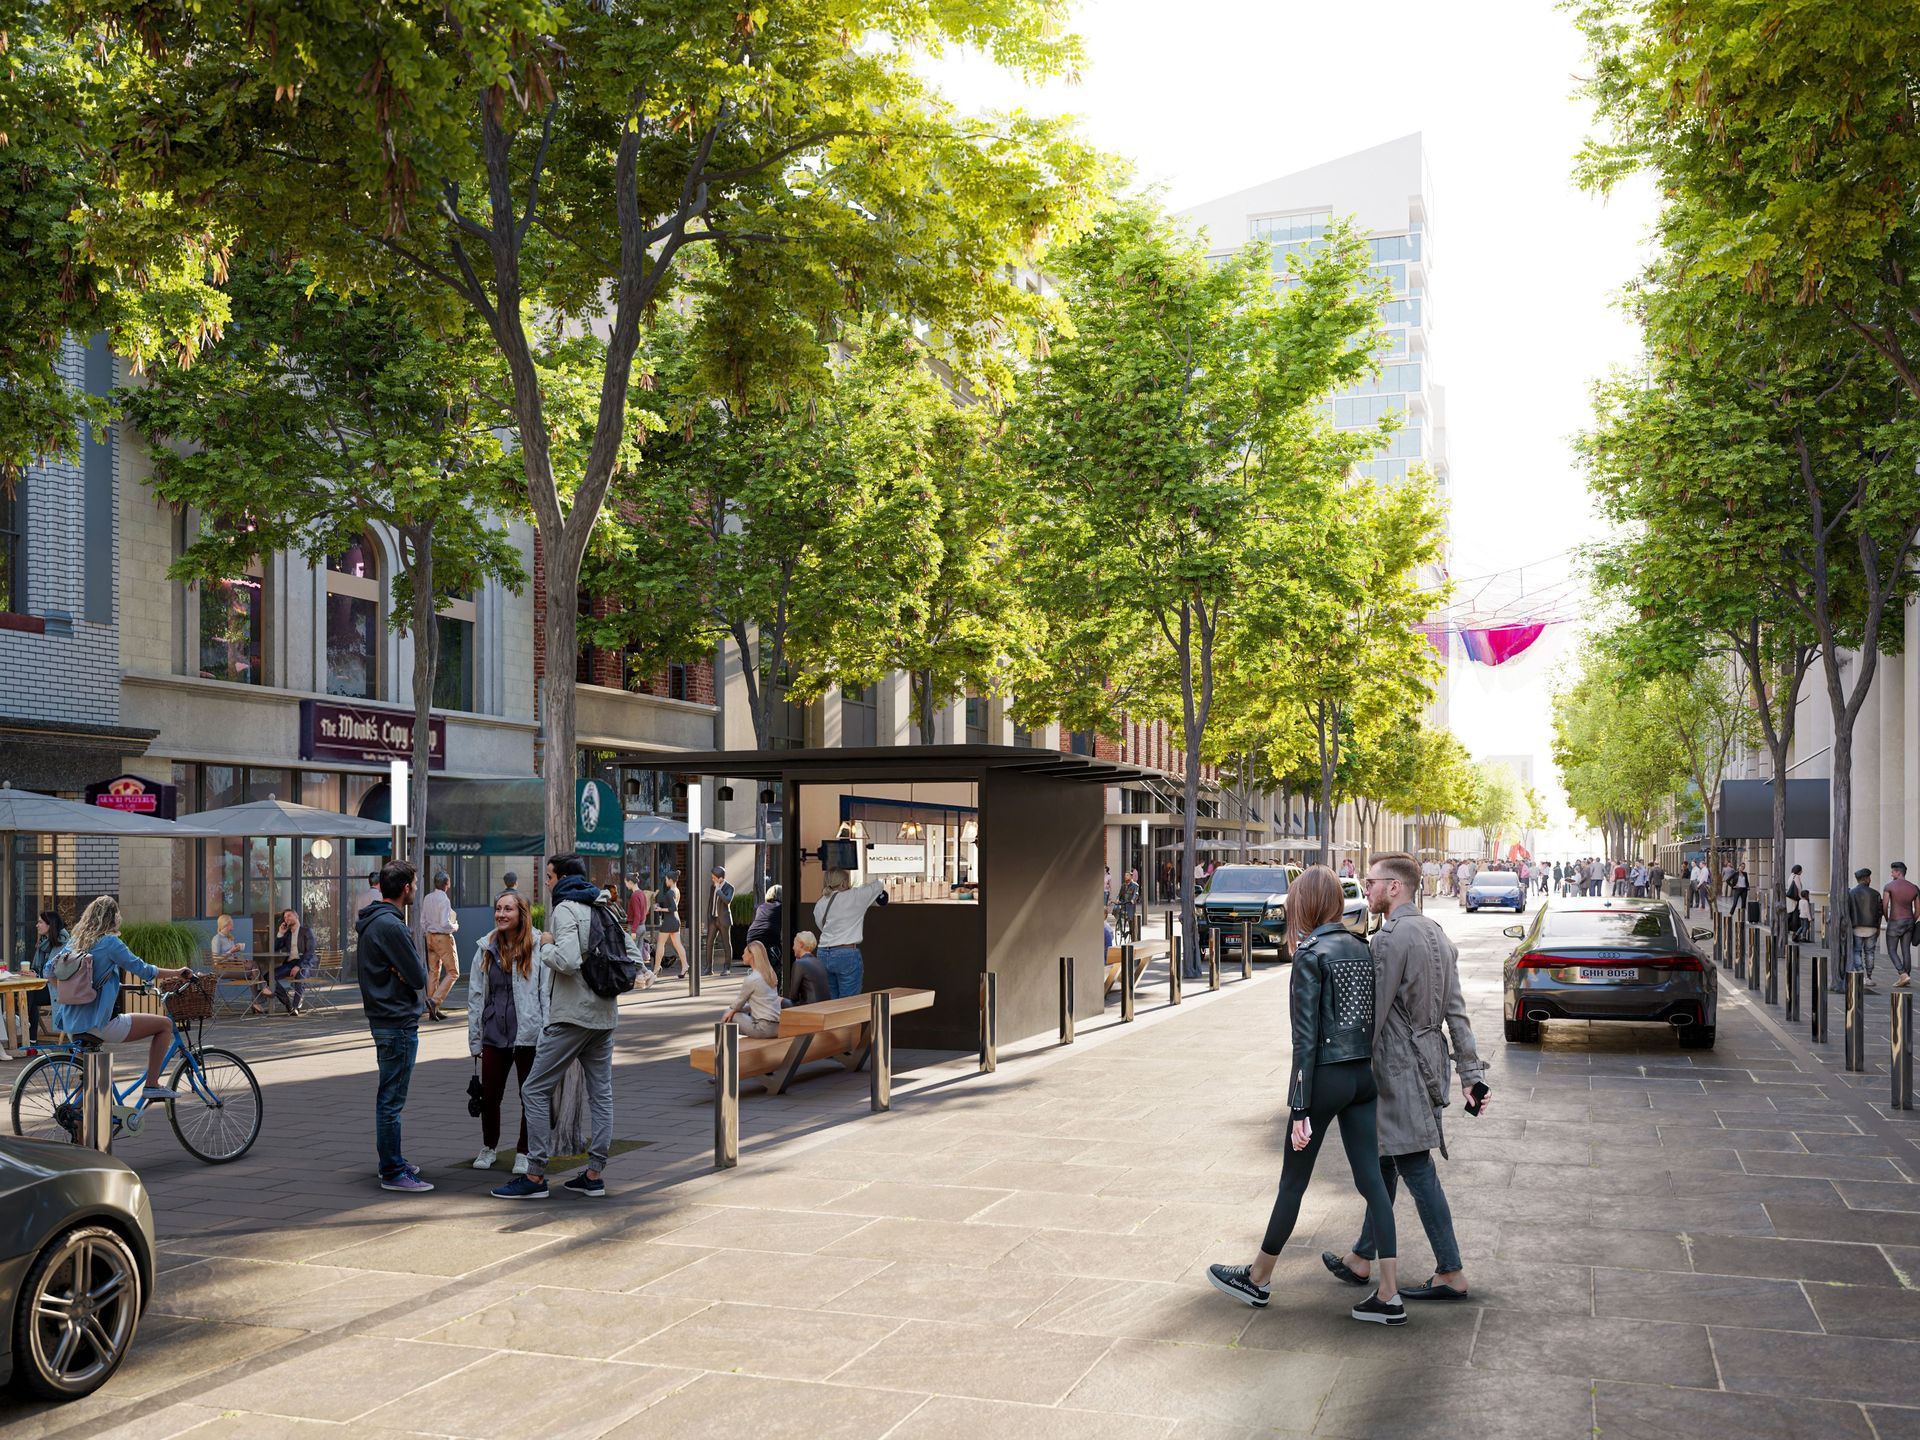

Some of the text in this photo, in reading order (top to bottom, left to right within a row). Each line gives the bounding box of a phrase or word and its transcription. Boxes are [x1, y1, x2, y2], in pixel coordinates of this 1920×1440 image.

[320, 718, 337, 738] The
[338, 713, 378, 741] Monk's
[382, 721, 409, 750] Copy
[1582, 969, 1635, 977] GHH 8058
